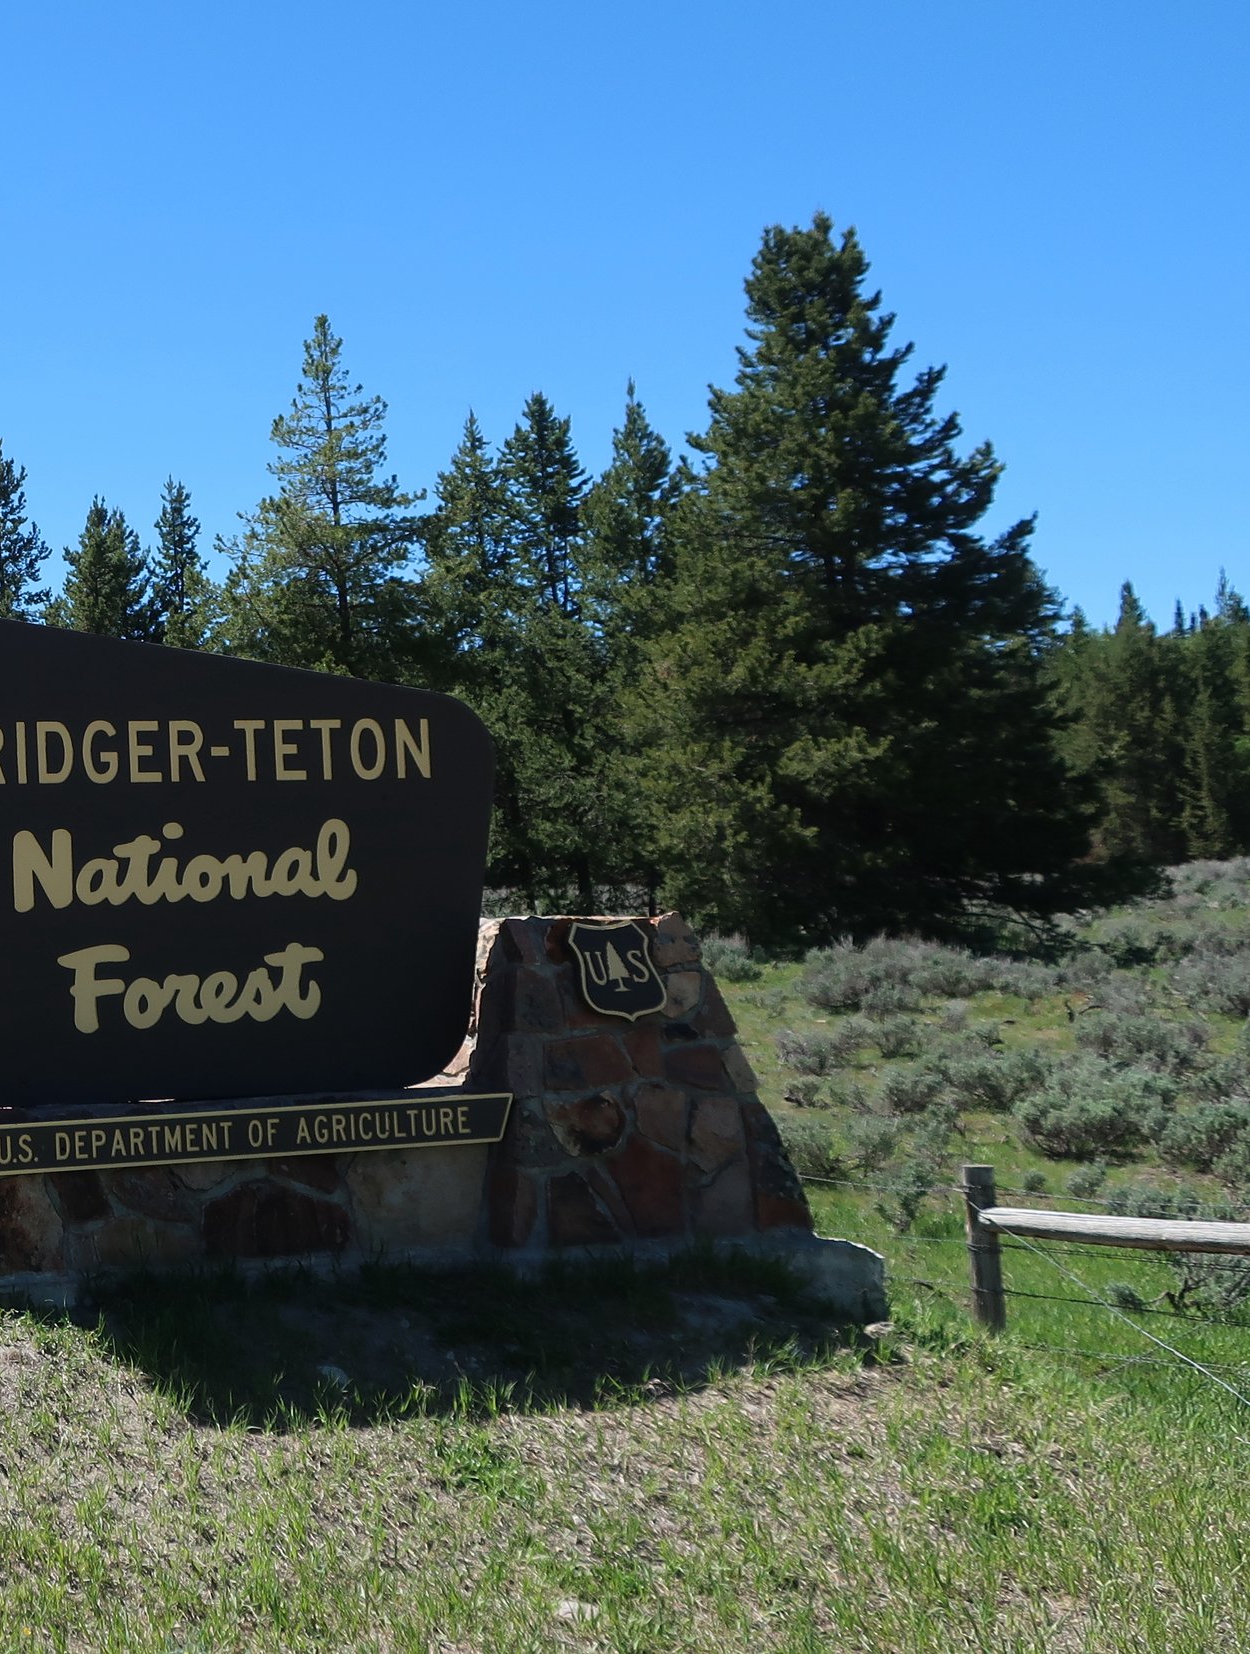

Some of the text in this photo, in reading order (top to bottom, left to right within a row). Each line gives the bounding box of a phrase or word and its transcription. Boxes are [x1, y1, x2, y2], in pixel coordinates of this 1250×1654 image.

[13, 818, 357, 912] National
[57, 942, 324, 1034] Forest
[54, 1121, 233, 1162] DEPARTMENT
[249, 1118, 280, 1148] OF
[295, 1106, 472, 1144] AGRICULTURE
